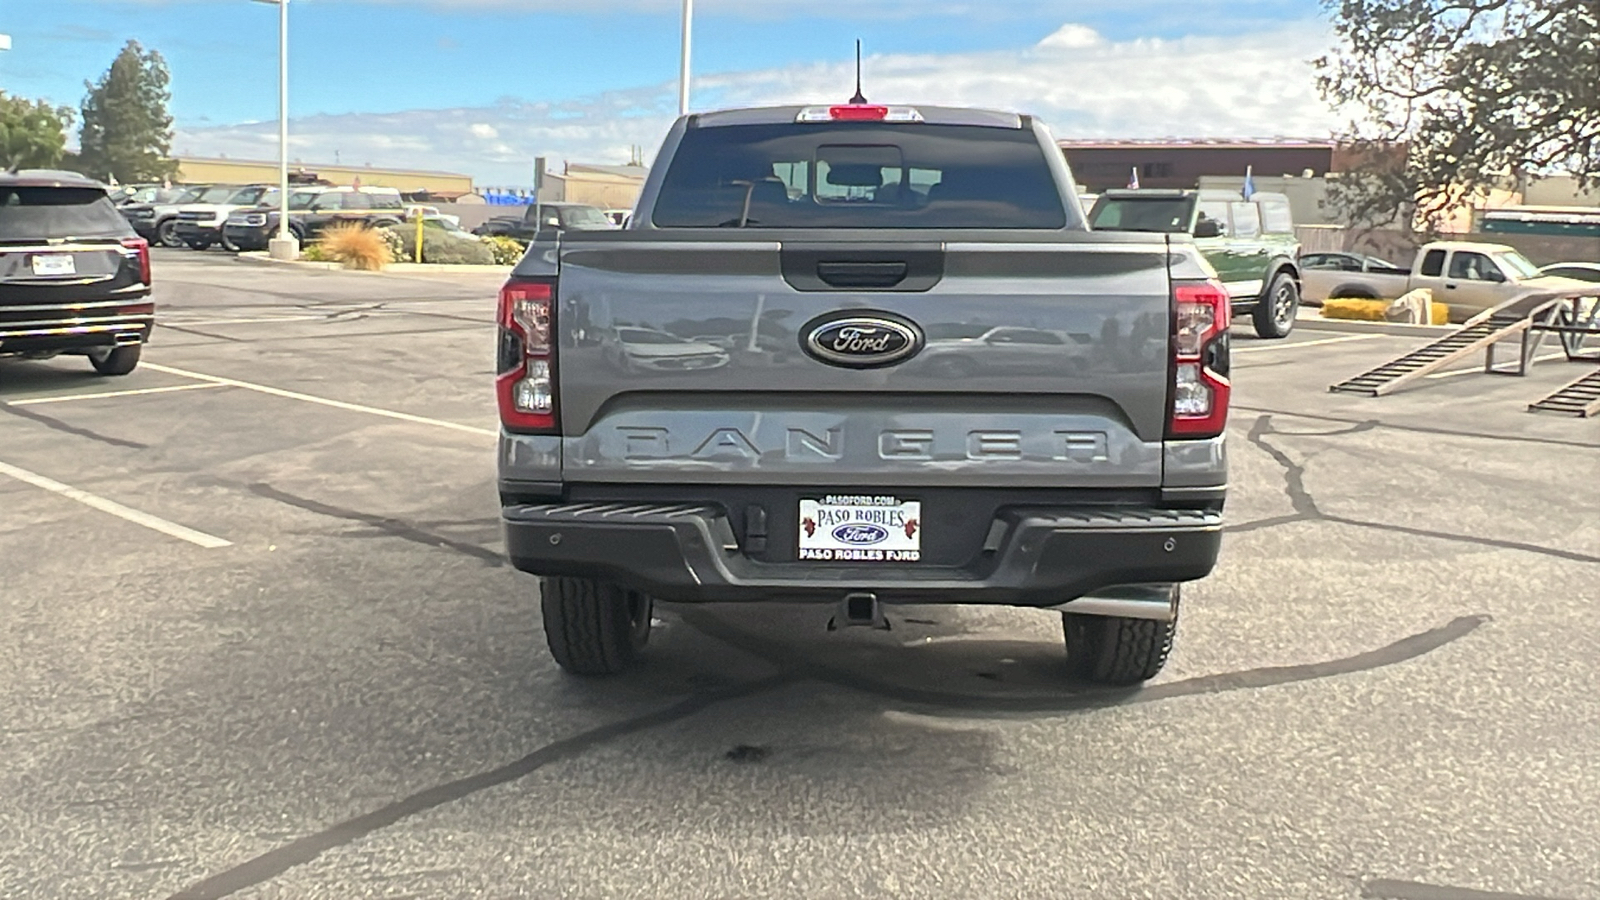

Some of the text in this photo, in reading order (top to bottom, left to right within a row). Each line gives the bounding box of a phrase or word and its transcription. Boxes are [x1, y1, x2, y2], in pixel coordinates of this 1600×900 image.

[833, 327, 890, 351] Ford
[614, 426, 1109, 462] RANGER
[826, 495, 895, 505] PASOFORD.COM
[817, 510, 905, 528] PASO ROBLES
[844, 527, 878, 541] Ford
[800, 549, 920, 560] PASO ROBLES FORD
